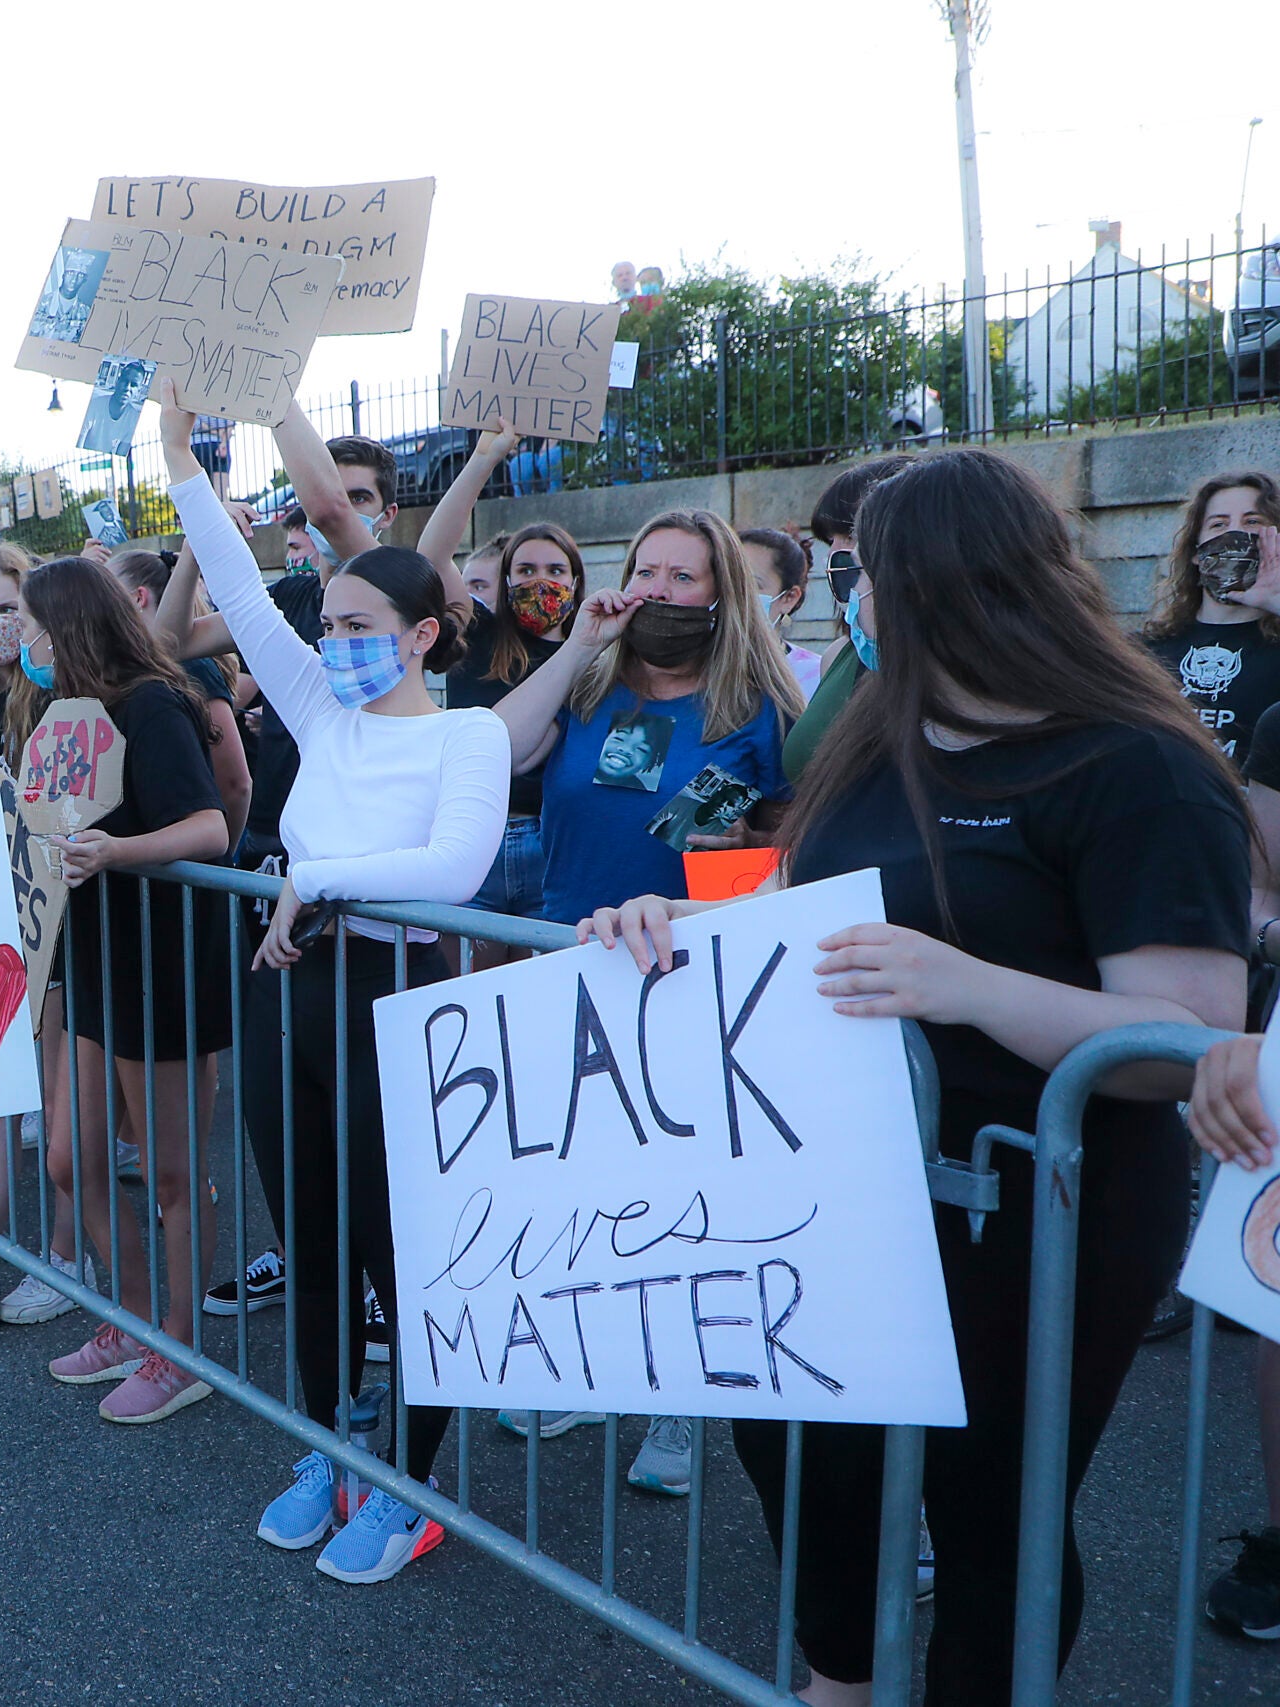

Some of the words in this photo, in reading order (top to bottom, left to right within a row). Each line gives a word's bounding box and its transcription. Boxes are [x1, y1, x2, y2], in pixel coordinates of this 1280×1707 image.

[108, 177, 200, 219] LET'S
[235, 188, 346, 223] BUILD
[362, 188, 387, 213] A
[129, 229, 308, 323] BLACK
[475, 299, 604, 351] BLACK
[463, 345, 587, 393] LIVES
[452, 388, 595, 438] MATTER
[24, 717, 114, 803] STOP
[424, 934, 804, 1174] BLACK
[423, 1186, 818, 1291] lives
[424, 1257, 847, 1397] MATTER
